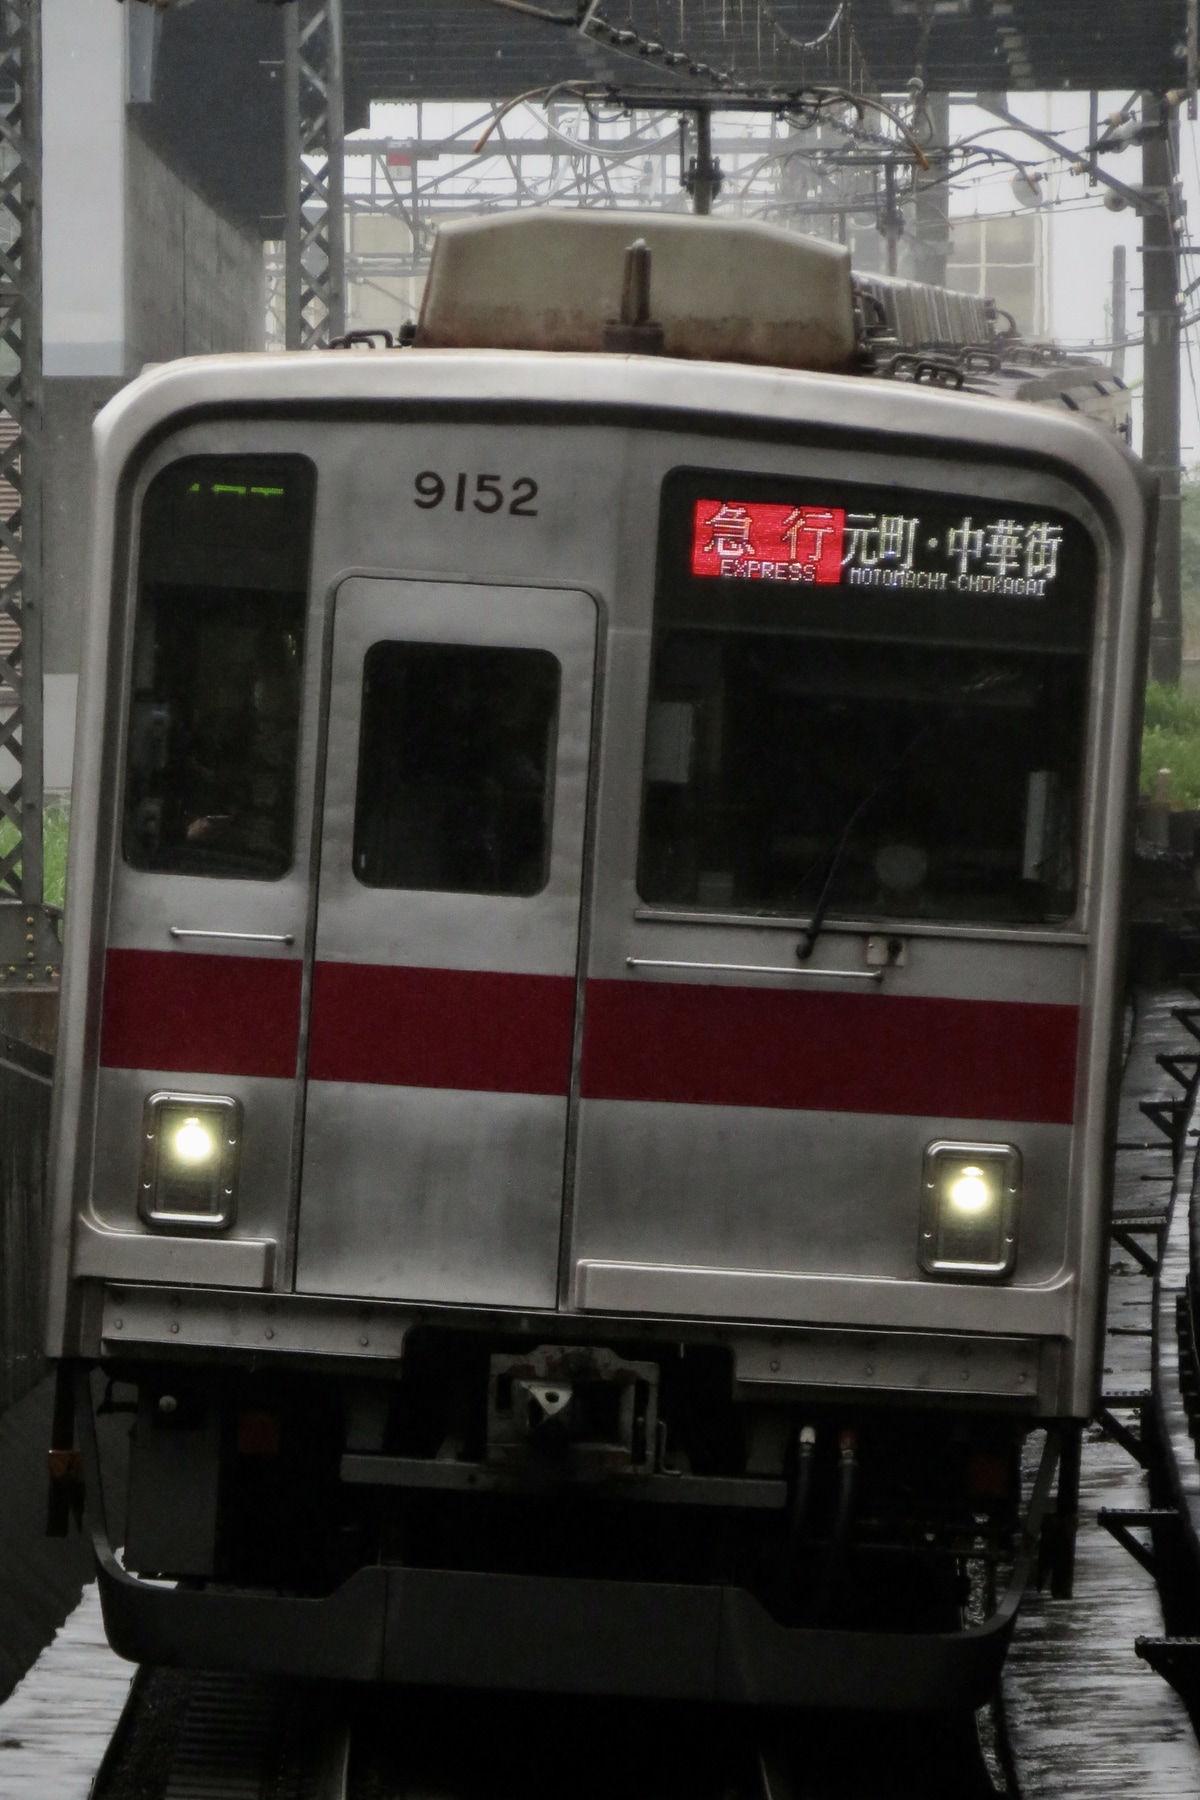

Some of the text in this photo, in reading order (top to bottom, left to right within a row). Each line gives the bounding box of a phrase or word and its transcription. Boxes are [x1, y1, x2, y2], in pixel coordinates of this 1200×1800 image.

[414, 471, 538, 516] 9152
[703, 503, 835, 561] 急行
[720, 559, 816, 582] EXPRESS
